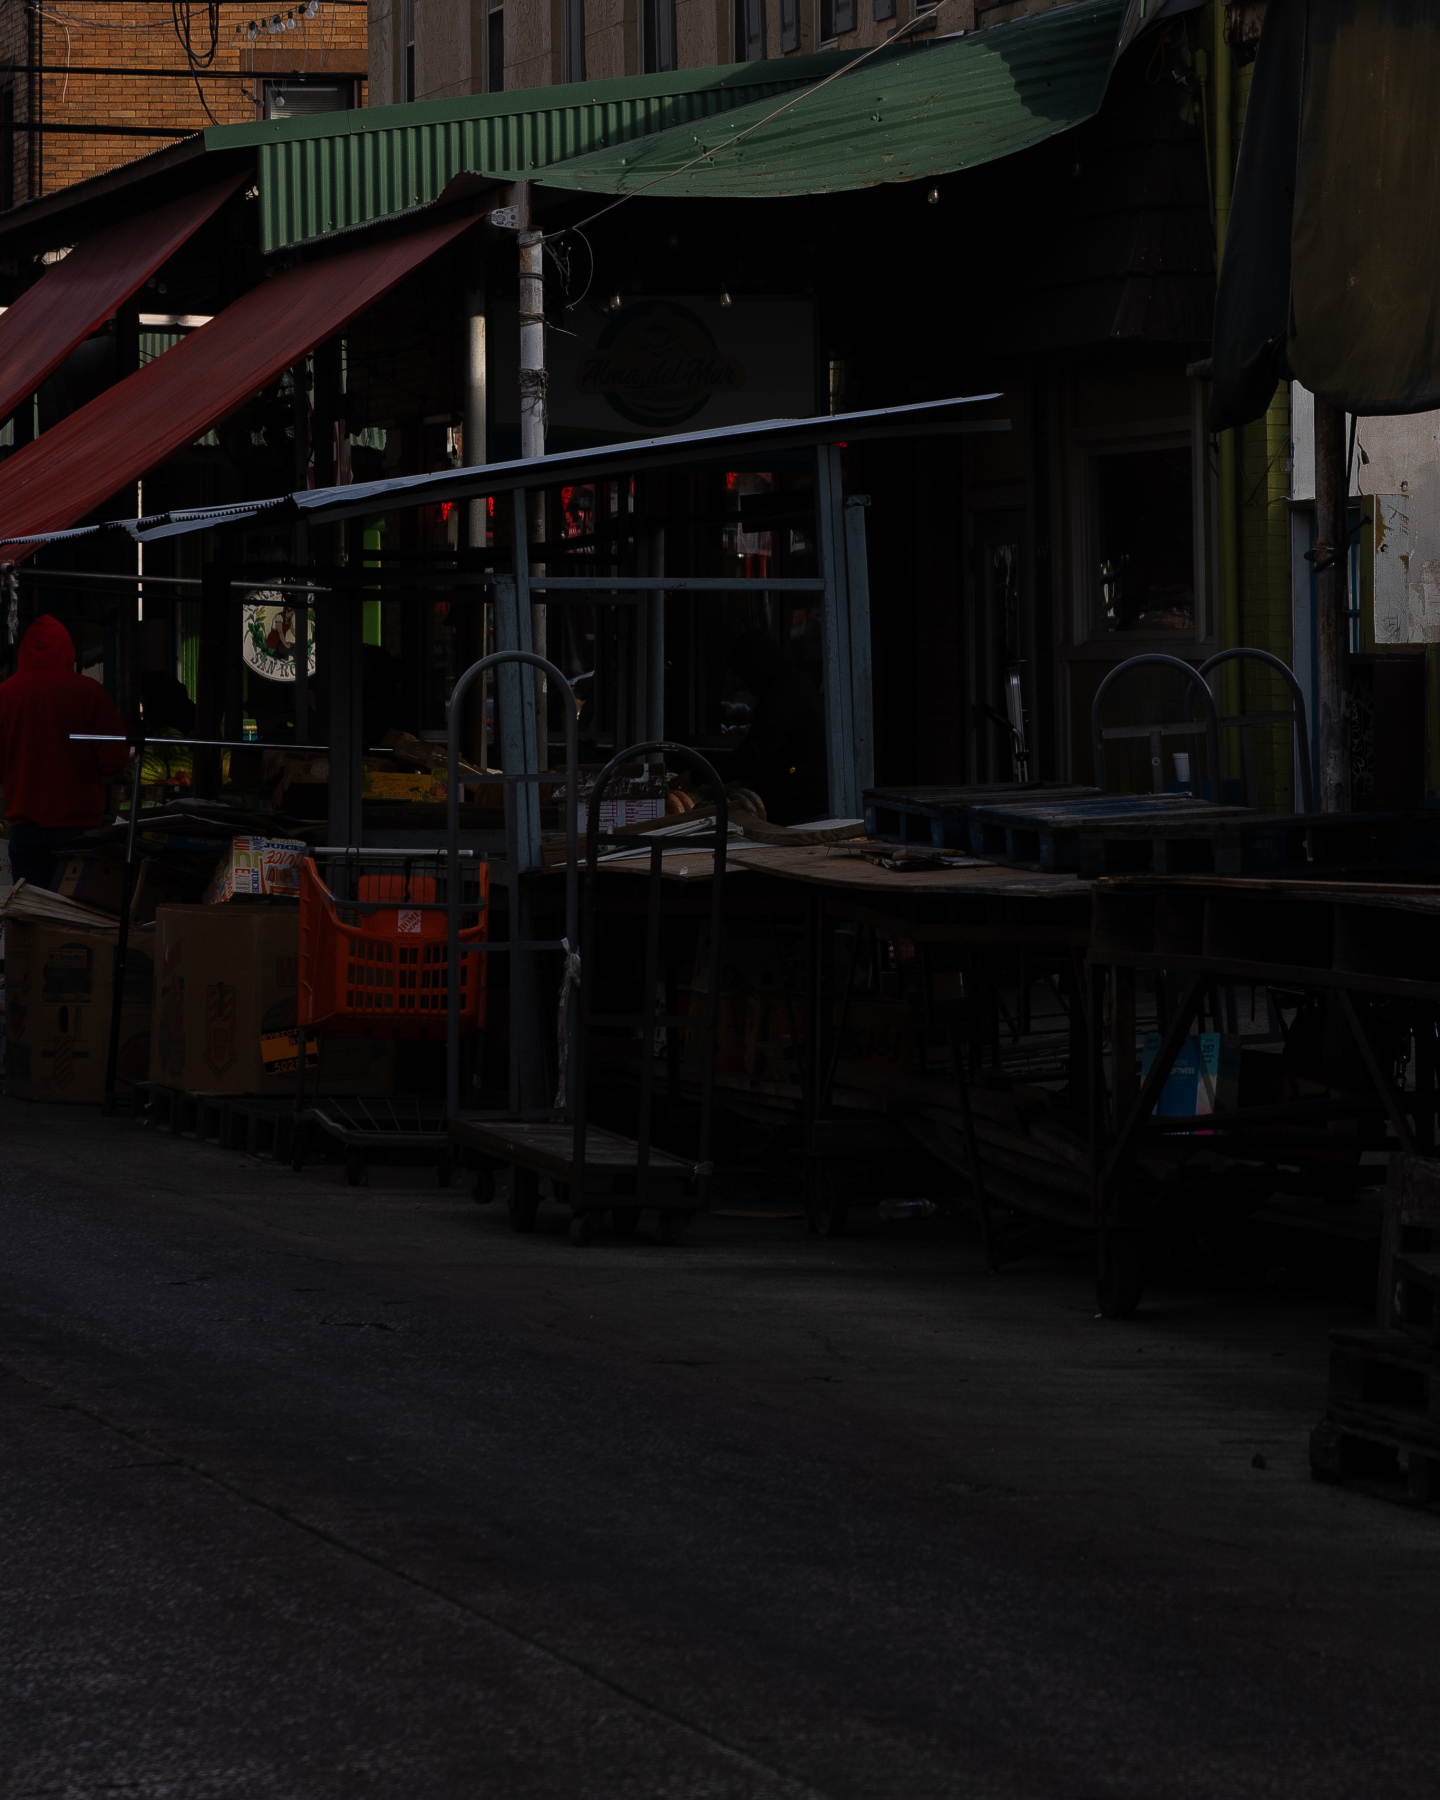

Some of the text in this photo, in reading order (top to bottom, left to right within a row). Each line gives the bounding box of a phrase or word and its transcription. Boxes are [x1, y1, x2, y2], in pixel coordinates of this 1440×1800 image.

[581, 358, 736, 387] Alma del Mar
[252, 653, 277, 675] SAN
[264, 843, 303, 851] JUICE
[1203, 1044, 1215, 1053] 257
[1170, 1067, 1195, 1075] OFTNESS
